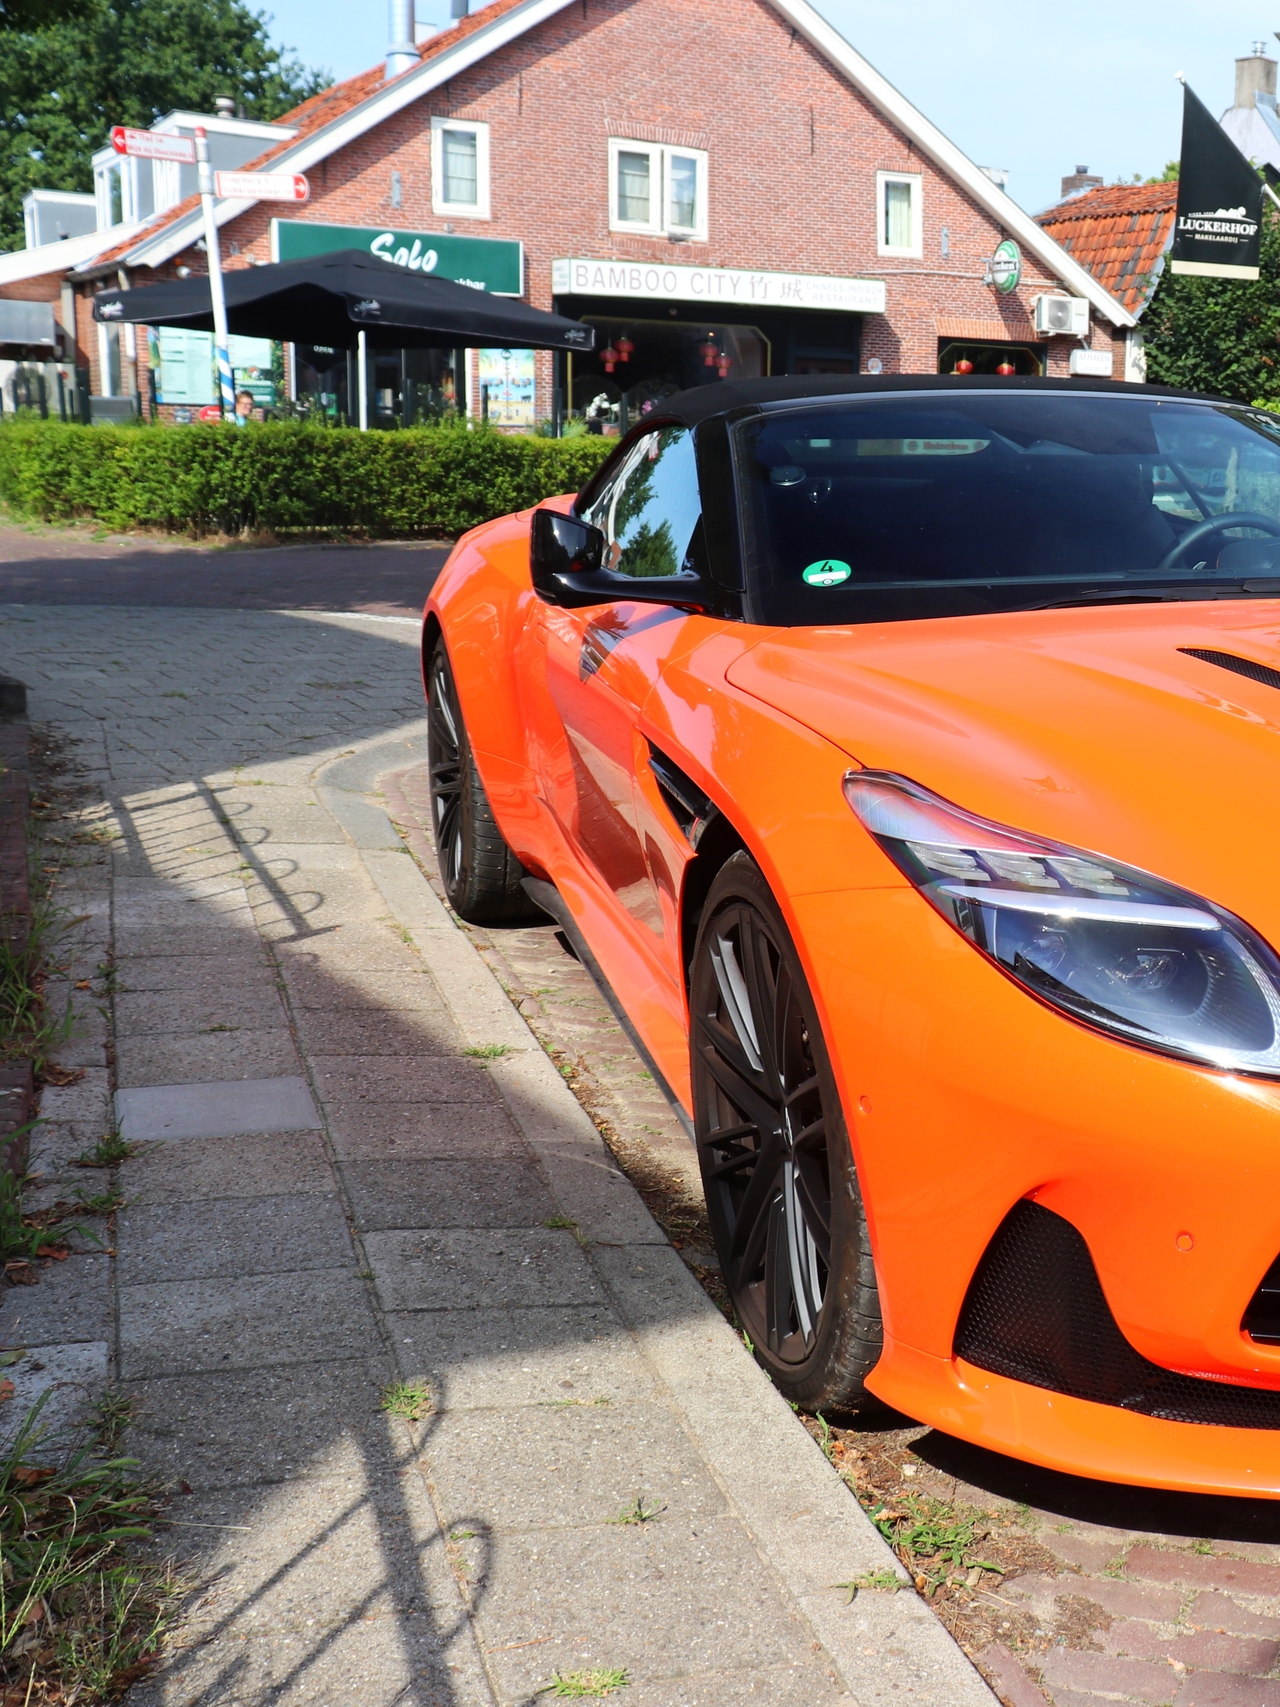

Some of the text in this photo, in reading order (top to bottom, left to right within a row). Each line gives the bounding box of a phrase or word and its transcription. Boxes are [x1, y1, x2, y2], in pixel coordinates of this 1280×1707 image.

[127, 145, 142, 153] Wijk
[1177, 216, 1258, 236] LUCKERHOF
[1194, 233, 1239, 244] MAKELAARDIJ
[370, 232, 439, 273] Solo
[576, 264, 677, 293] BAMBOO
[690, 272, 741, 296] CITY
[805, 280, 883, 296] CHINEES-INDISCH
[811, 292, 878, 305] RESTAURANT
[313, 345, 335, 354] OPEN
[1078, 352, 1110, 362] AFHALEN
[923, 440, 969, 451] Heineken
[820, 560, 834, 573] 4
